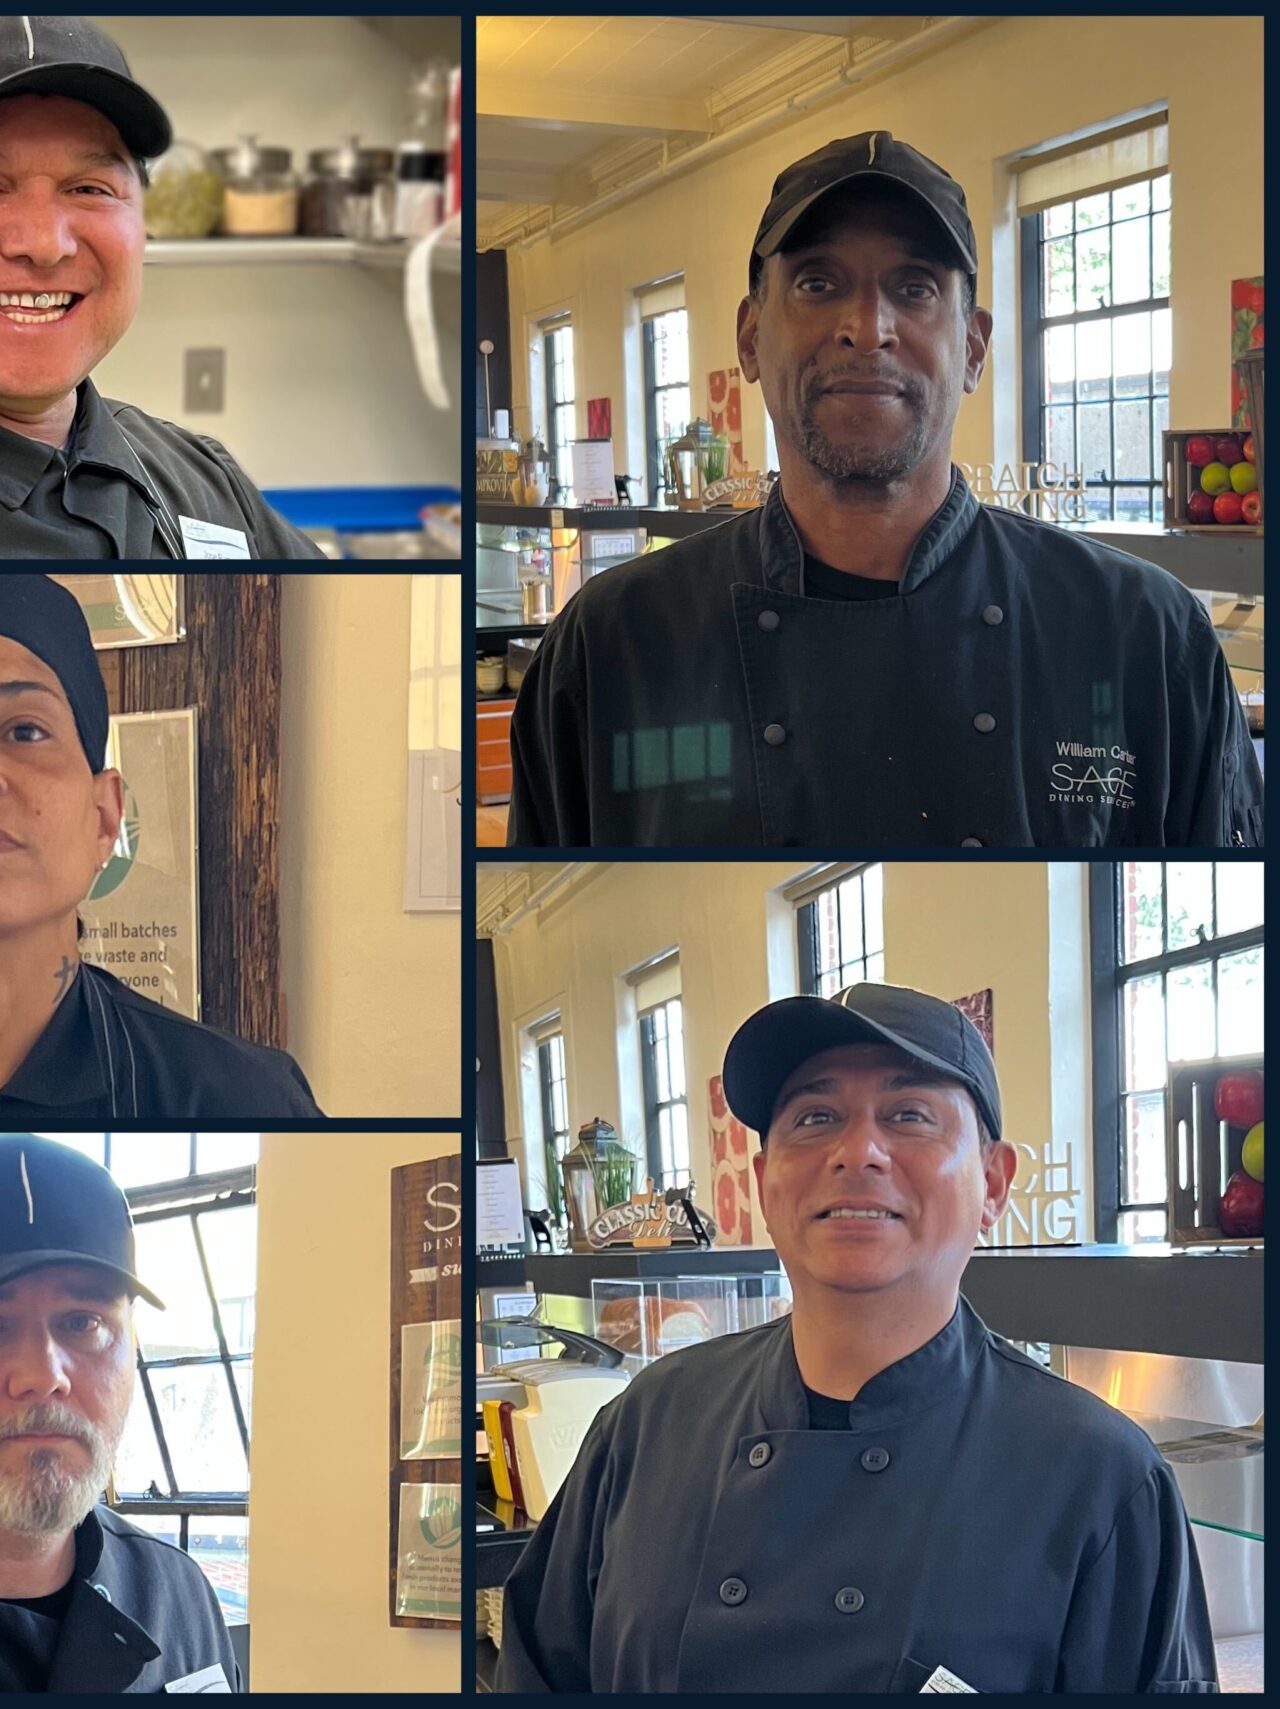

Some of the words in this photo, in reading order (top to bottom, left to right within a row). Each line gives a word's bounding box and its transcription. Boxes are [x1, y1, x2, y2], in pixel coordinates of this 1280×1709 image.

[1056, 741, 1106, 757] William
[1050, 763, 1136, 800] SAGE
[1049, 794, 1094, 803] DINING
[121, 921, 178, 938] batches
[96, 949, 136, 963] waste
[140, 945, 167, 962] and
[594, 1203, 661, 1239] CLASSIC
[629, 1219, 673, 1238] Deli
